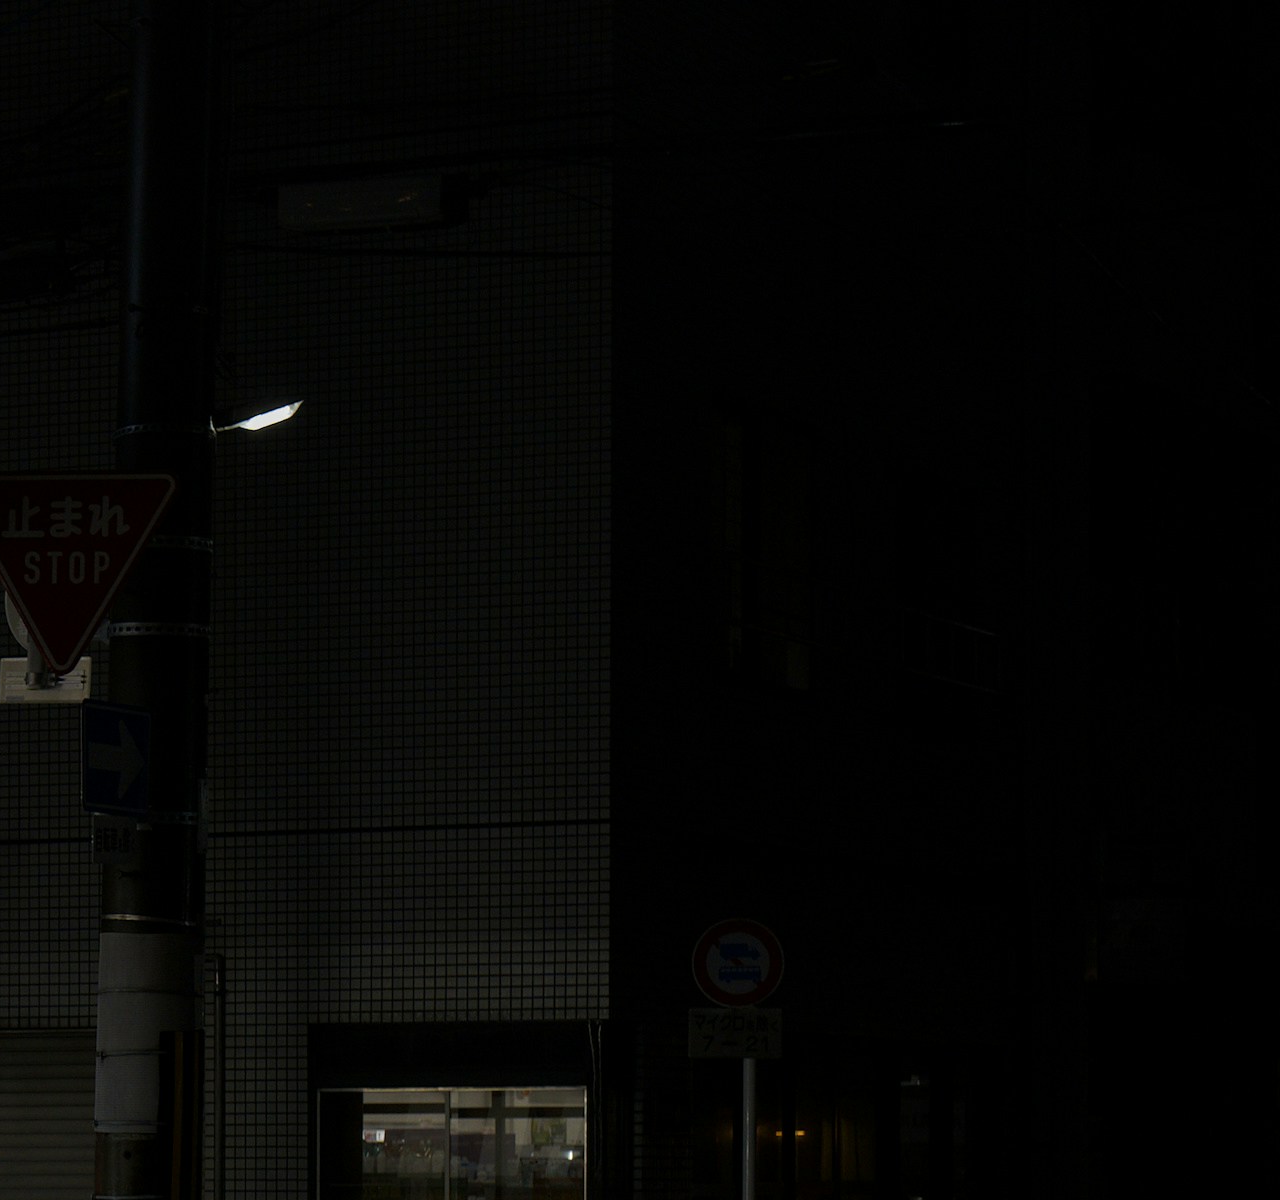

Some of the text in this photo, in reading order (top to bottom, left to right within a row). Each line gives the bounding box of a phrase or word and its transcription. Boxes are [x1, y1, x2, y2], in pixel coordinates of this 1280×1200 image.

[0, 495, 131, 540] 止まれ
[23, 549, 111, 585] STOP
